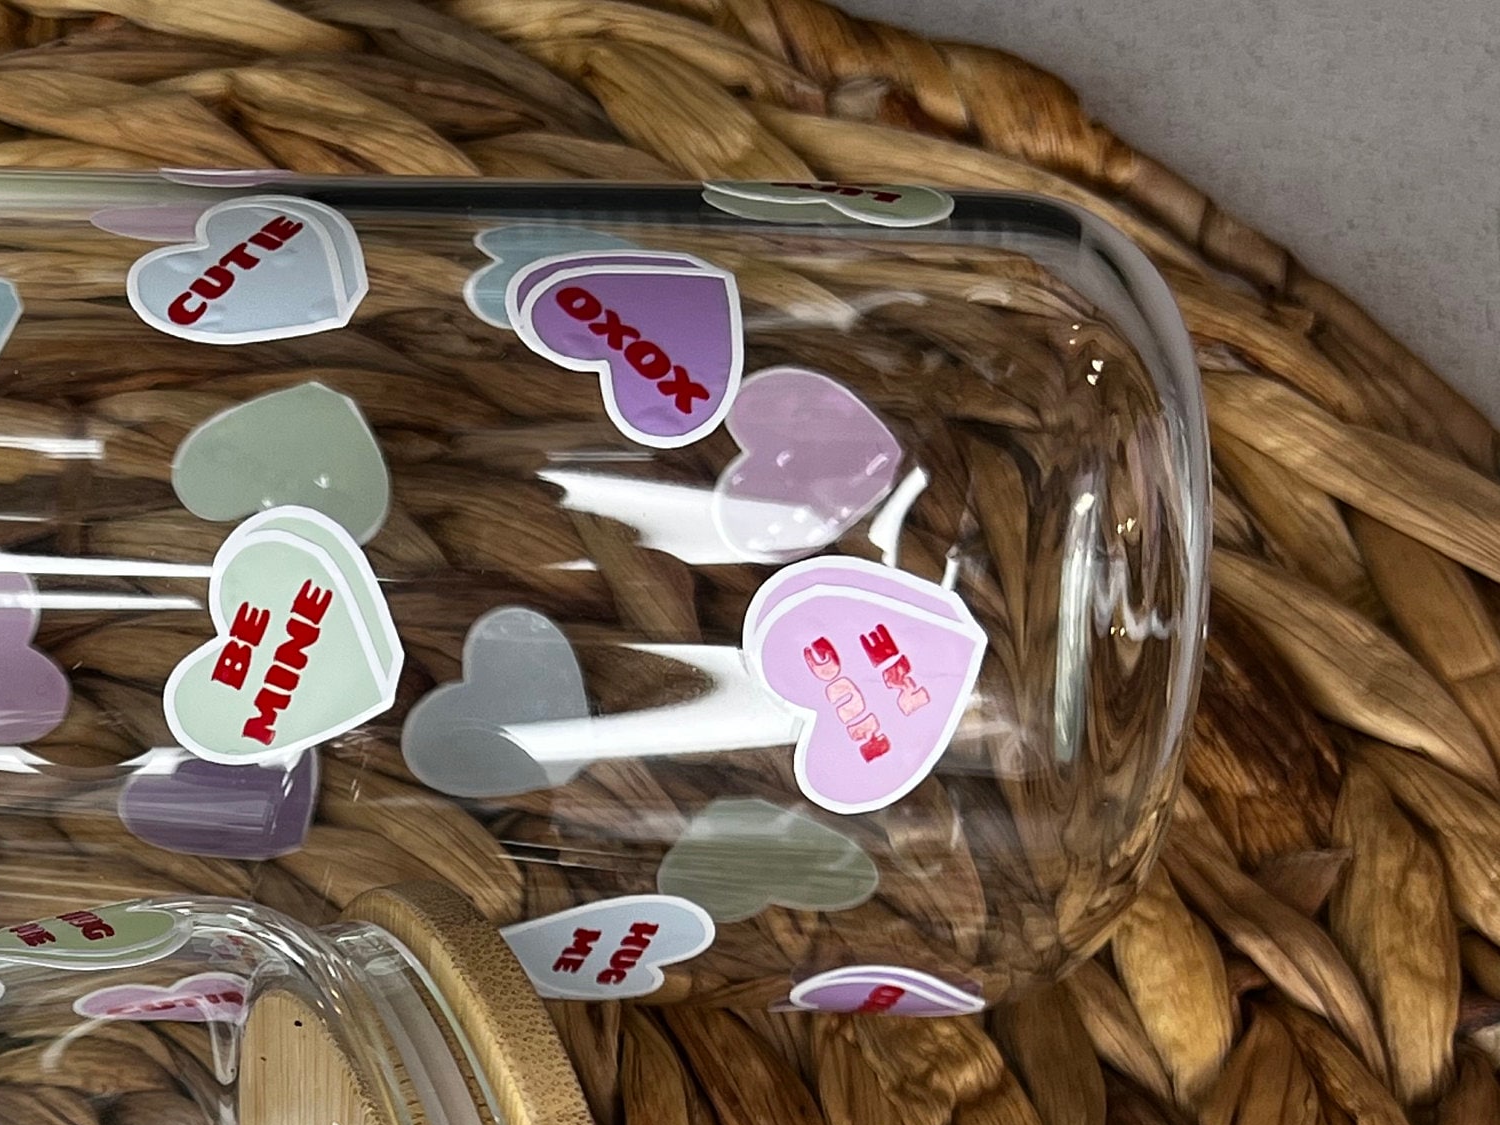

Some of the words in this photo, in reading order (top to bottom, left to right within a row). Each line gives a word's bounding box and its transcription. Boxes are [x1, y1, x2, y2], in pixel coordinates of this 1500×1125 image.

[167, 215, 304, 325] CUTIE
[211, 601, 270, 691] BE
[241, 578, 334, 746] MINE
[859, 623, 931, 717] ME
[803, 636, 891, 763] HUG
[552, 927, 602, 973] ME
[595, 922, 659, 985] HUG
